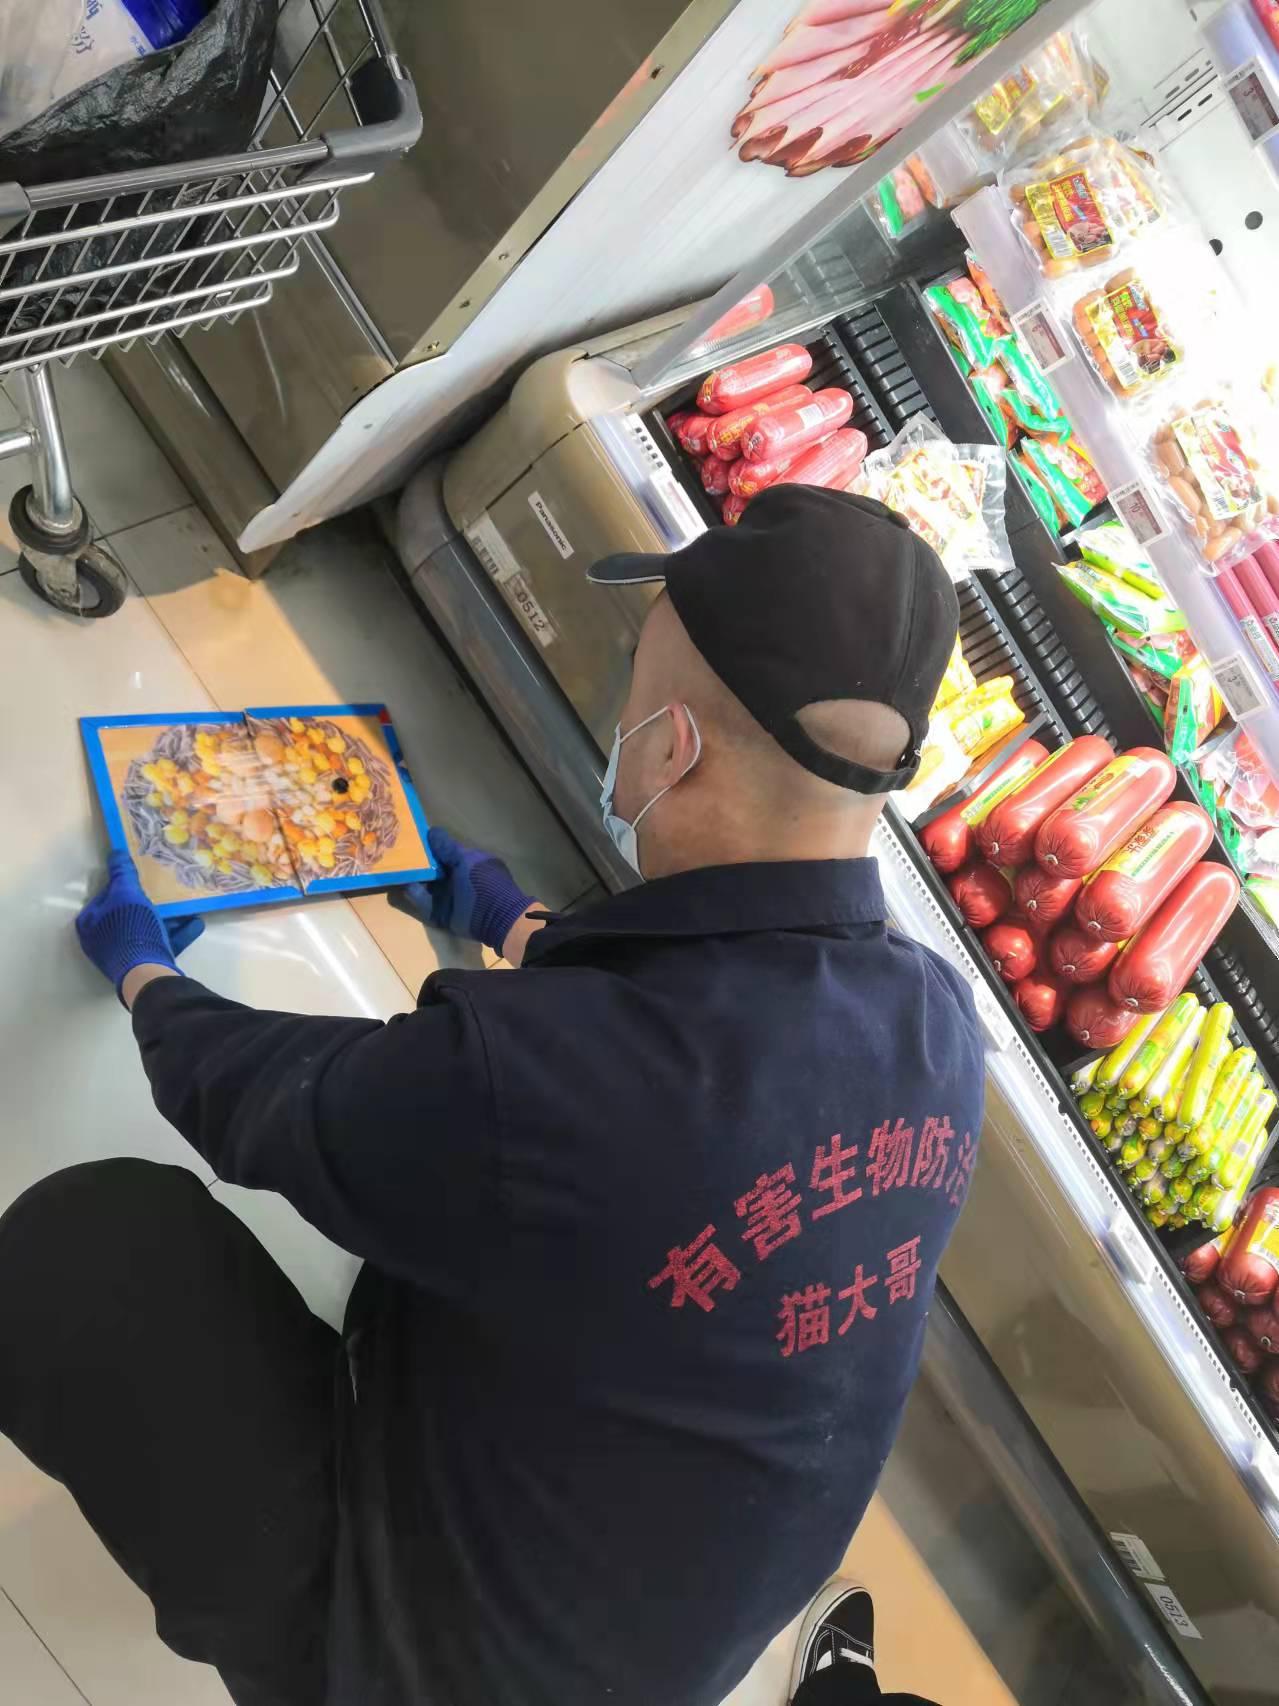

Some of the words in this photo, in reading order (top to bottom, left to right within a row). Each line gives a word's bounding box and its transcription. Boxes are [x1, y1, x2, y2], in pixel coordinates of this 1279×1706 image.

[535, 501, 567, 552] Panasonic
[516, 591, 545, 632] 0512
[776, 1235, 922, 1358] 猫大哥
[1160, 1596, 1189, 1627] 0513
